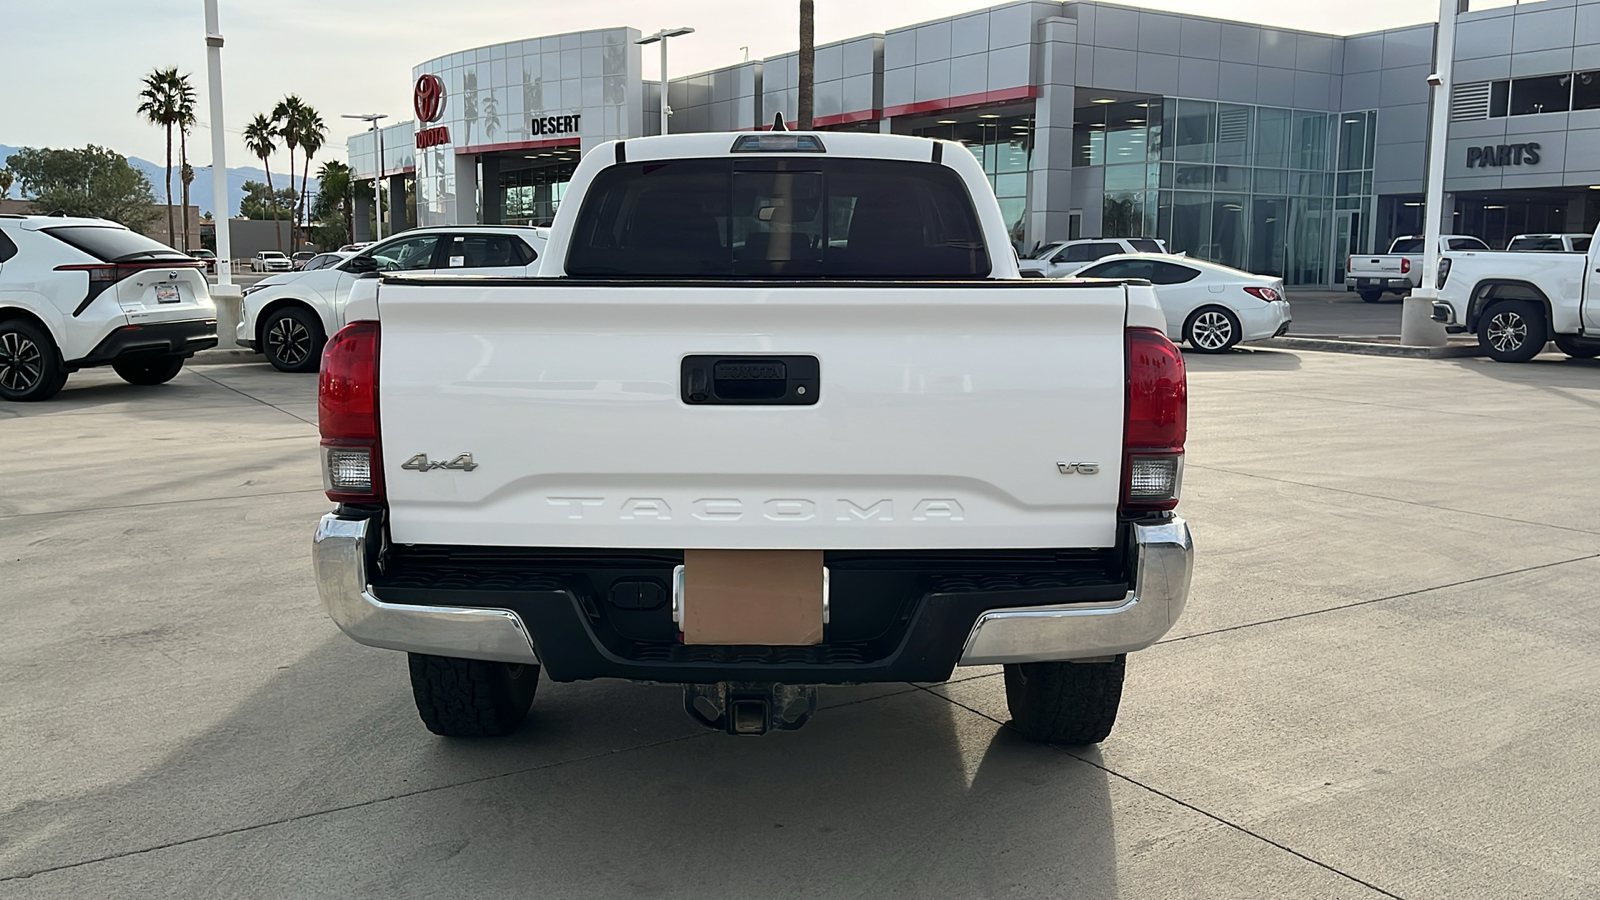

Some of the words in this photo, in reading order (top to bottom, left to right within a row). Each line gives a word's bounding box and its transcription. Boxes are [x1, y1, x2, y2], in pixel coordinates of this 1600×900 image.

[531, 114, 581, 135] DESERT
[415, 127, 449, 148] TOYOTA
[1466, 142, 1541, 168] PARTS
[720, 365, 780, 378] TOYOTA
[401, 452, 478, 472] 4x4
[1056, 461, 1100, 475] V6
[546, 496, 966, 521] TACOMA
